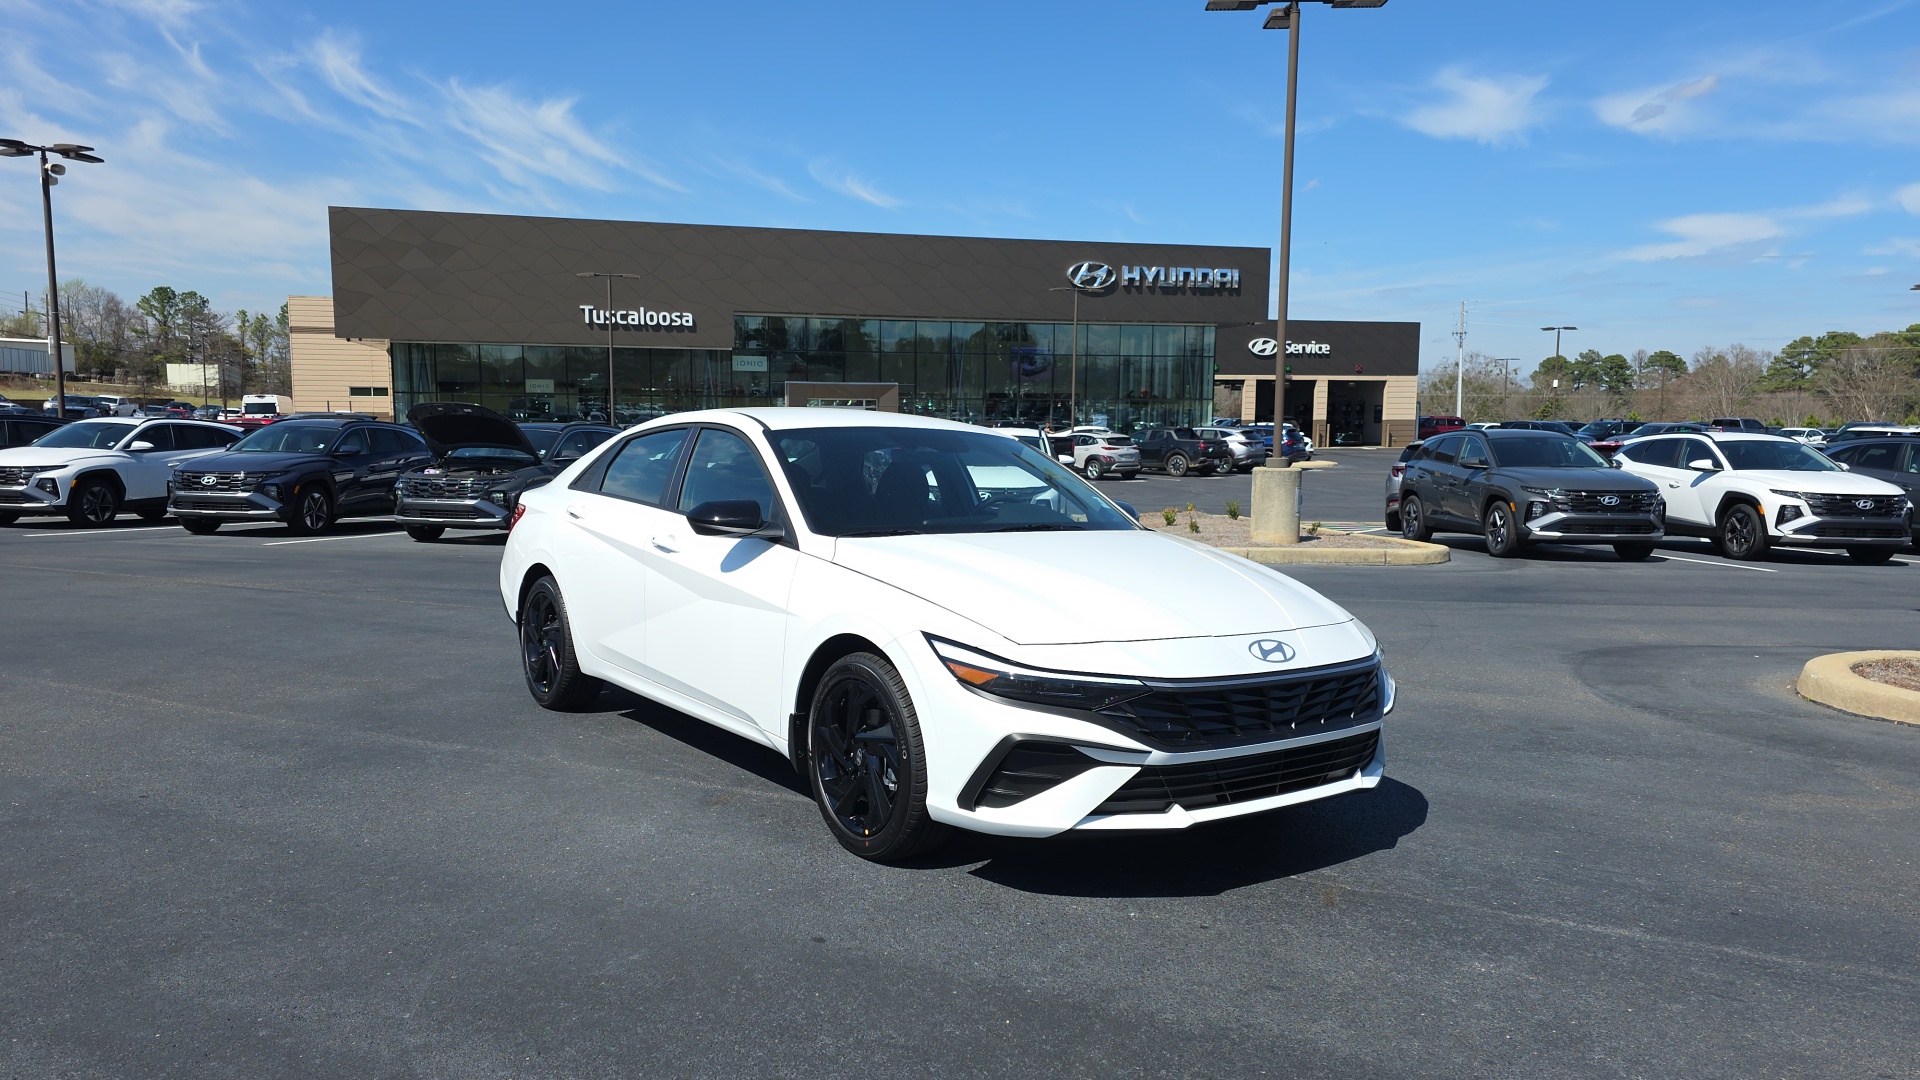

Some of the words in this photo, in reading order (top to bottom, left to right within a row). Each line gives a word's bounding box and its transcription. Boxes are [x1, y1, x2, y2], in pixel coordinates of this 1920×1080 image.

[1121, 265, 1239, 288] HYUNDAI
[579, 305, 693, 327] Tuscaloosa
[1285, 340, 1330, 354] Service
